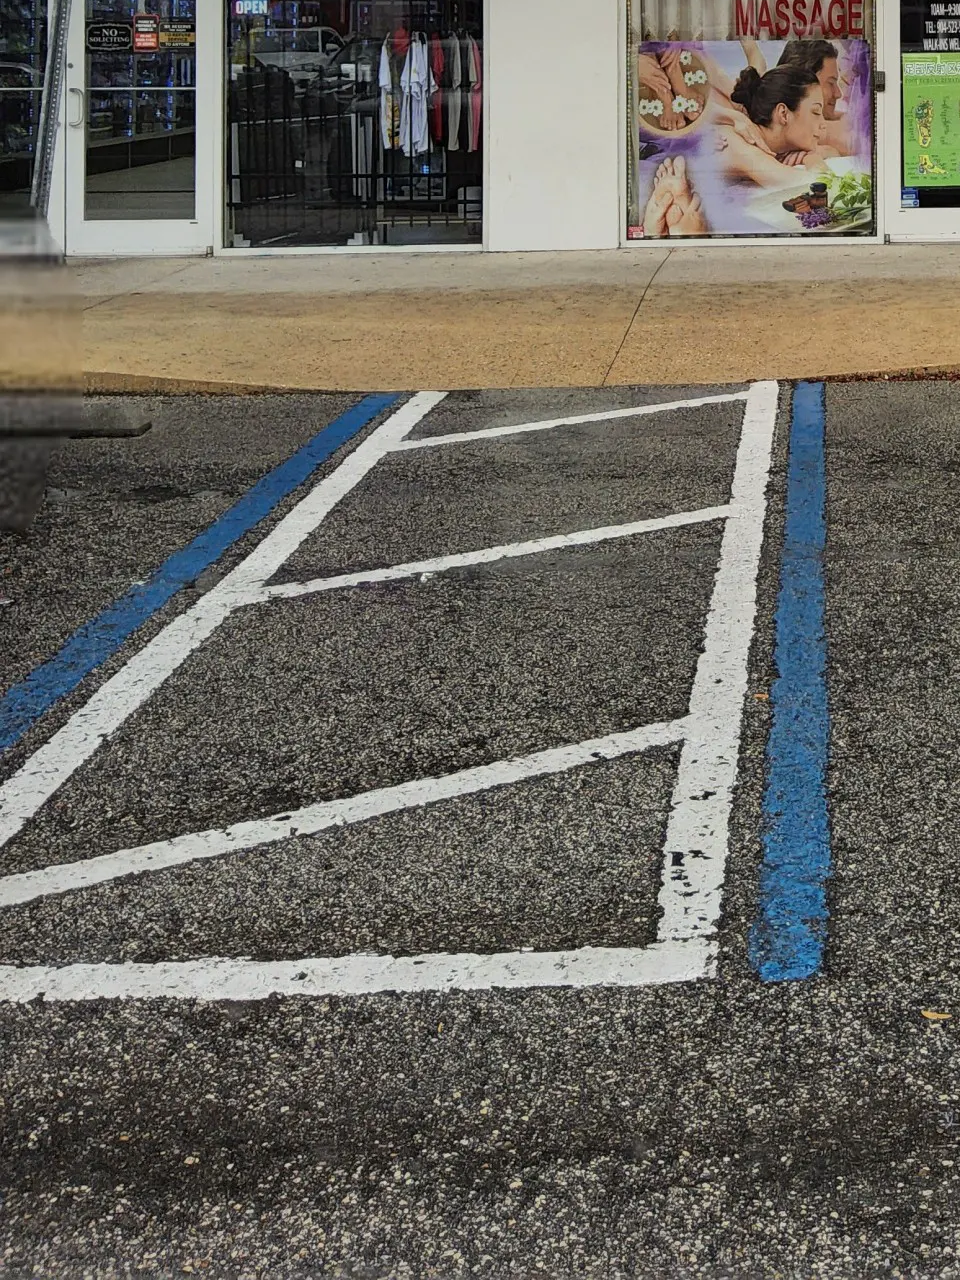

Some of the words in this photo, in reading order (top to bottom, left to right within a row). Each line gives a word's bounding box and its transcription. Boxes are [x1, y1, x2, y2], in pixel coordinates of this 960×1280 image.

[235, 0, 268, 15] OPEN
[101, 28, 118, 37] NO
[925, 21, 936, 34] TEL:
